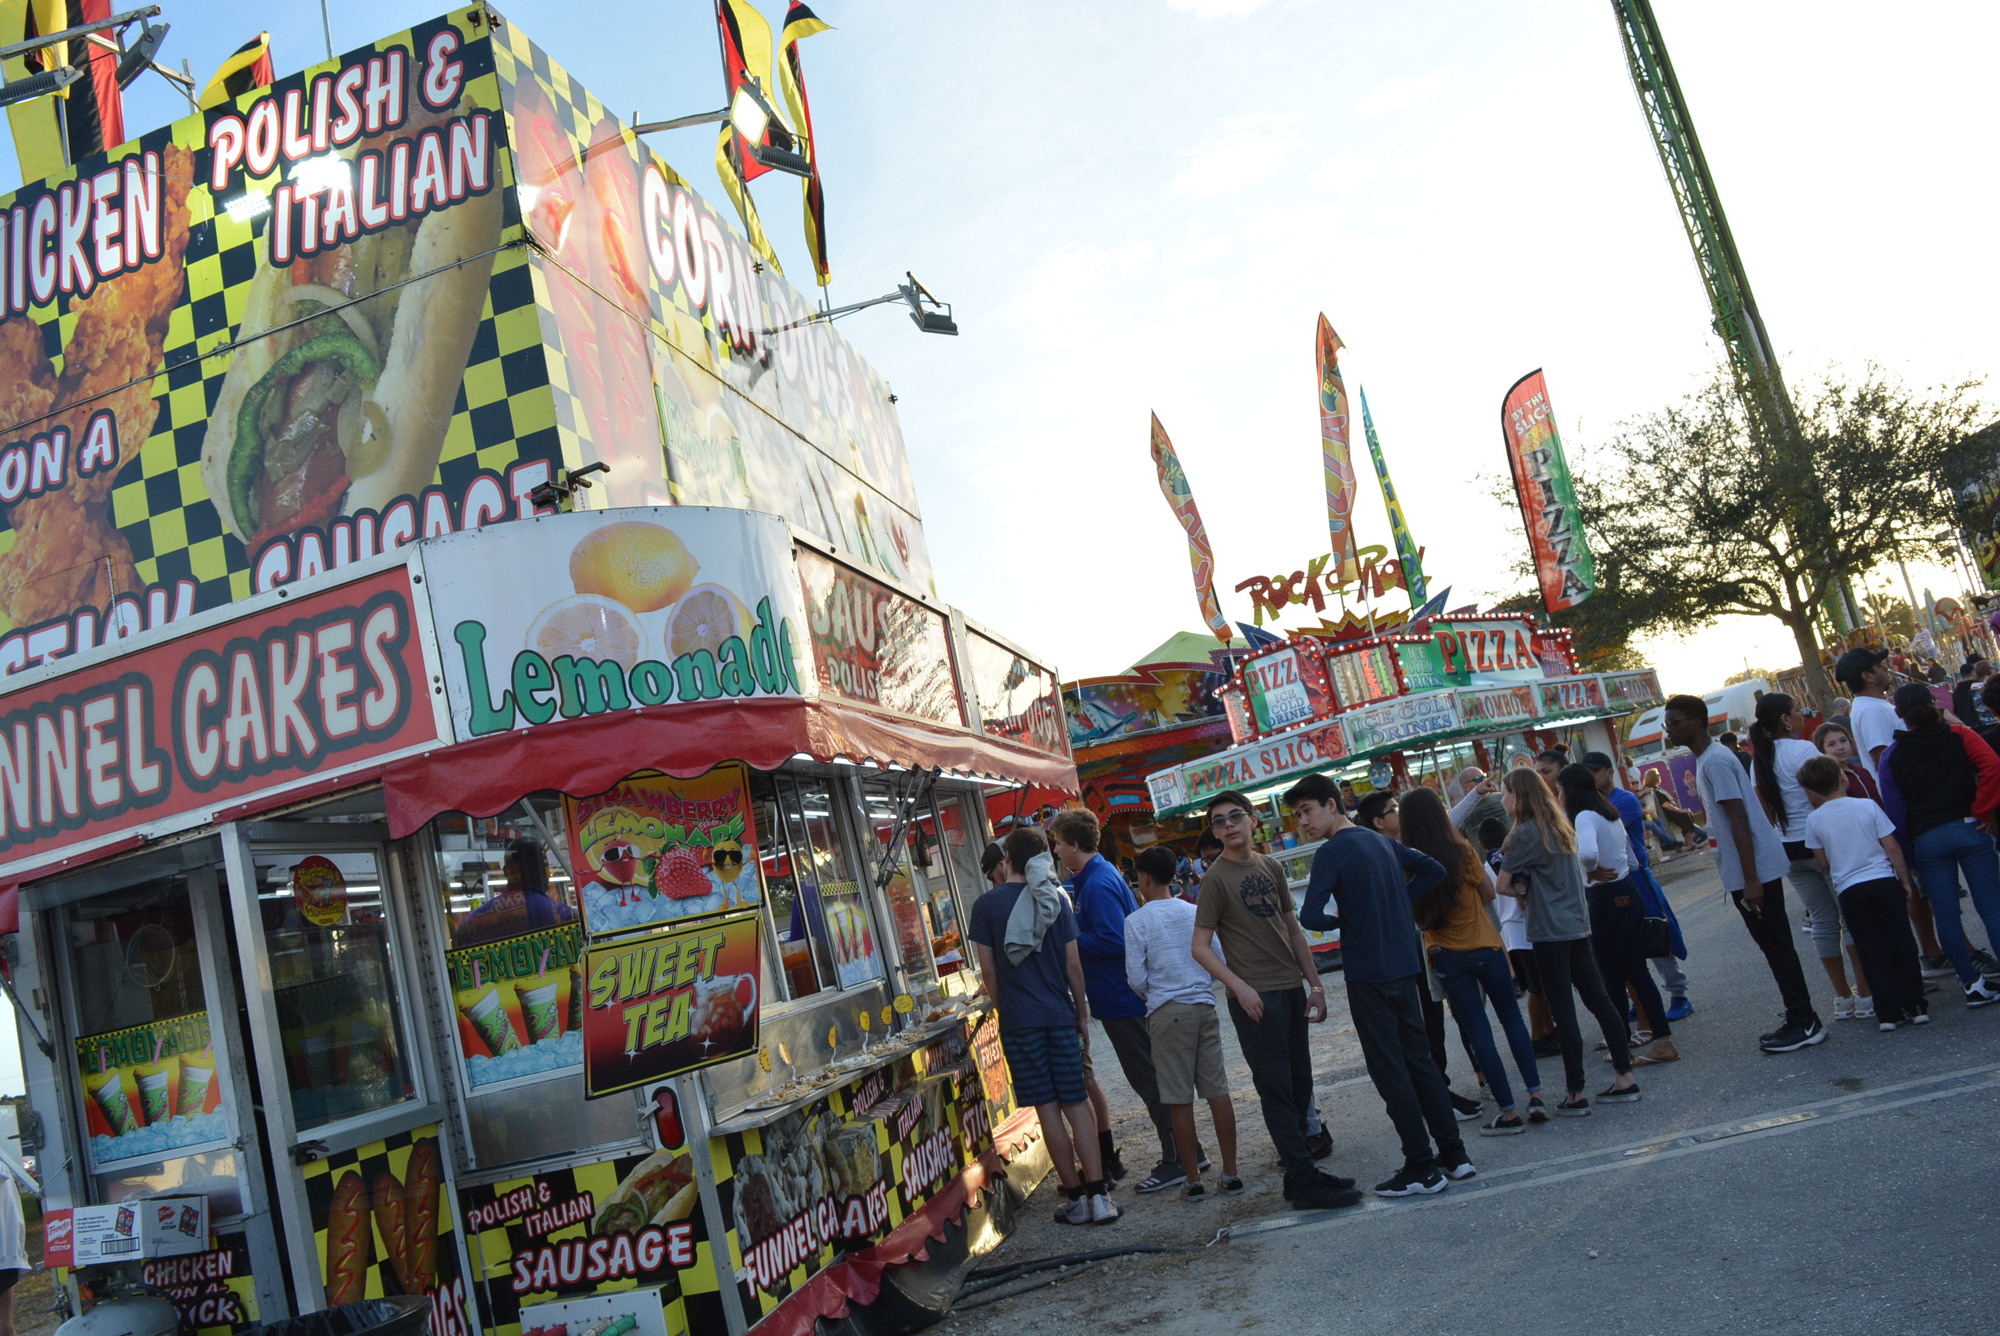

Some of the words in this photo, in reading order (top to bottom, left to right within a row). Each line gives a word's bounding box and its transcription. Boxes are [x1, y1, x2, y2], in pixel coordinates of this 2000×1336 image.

[209, 49, 404, 191] POLISH
[424, 30, 464, 106] &
[273, 113, 488, 263] ITALIAN
[642, 163, 768, 361] CORN
[1511, 408, 1525, 421] BY
[1525, 391, 1545, 410] THE
[1515, 402, 1551, 436] SLICE
[0, 432, 65, 500] ON
[80, 413, 115, 474] A
[1525, 446, 1592, 601] PIZZA
[1235, 552, 1331, 626] ROCK
[1356, 544, 1432, 604] RO
[453, 595, 808, 737] Lemonade
[1407, 646, 1426, 660] ICE
[1435, 627, 1538, 674] PIZZA
[1541, 639, 1556, 651] ICE
[1541, 651, 1564, 664] COLD
[827, 658, 879, 700] POLIS
[1246, 656, 1316, 696] PIZZA
[1404, 673, 1444, 690] DRINKS
[1406, 662, 1435, 676] COLD
[180, 602, 399, 779] CAKES
[1271, 696, 1306, 716] COLD
[1274, 688, 1297, 704] ICE
[1543, 681, 1597, 713] PIZZA
[1267, 706, 1315, 728] DRINKS
[1353, 710, 1394, 734] ICE
[1399, 694, 1453, 720] COLD
[1366, 715, 1453, 748] DRINKS
[1188, 757, 1256, 795] PIZZA
[1259, 726, 1345, 775] SLICES
[576, 785, 740, 824] STRAWBERRY
[579, 810, 745, 853] LEMONADE
[588, 931, 726, 1009] SWEET
[623, 990, 693, 1054] TEA
[973, 1016, 998, 1048] LOADED
[84, 1015, 212, 1075] LEMONADE
[980, 1041, 1001, 1069] FRIES
[853, 1076, 877, 1117] POLISH
[898, 1094, 923, 1143] ITALIAN
[902, 1126, 955, 1203] SAUSAGE
[467, 1186, 534, 1232] POLISH
[538, 1181, 551, 1203] &
[525, 1194, 593, 1238] ITALIAN
[143, 1250, 232, 1286] CHICKEN
[512, 1223, 692, 1293] SAUSAGE
[743, 1210, 817, 1298] FUNNEL
[170, 1285, 198, 1300] ON
